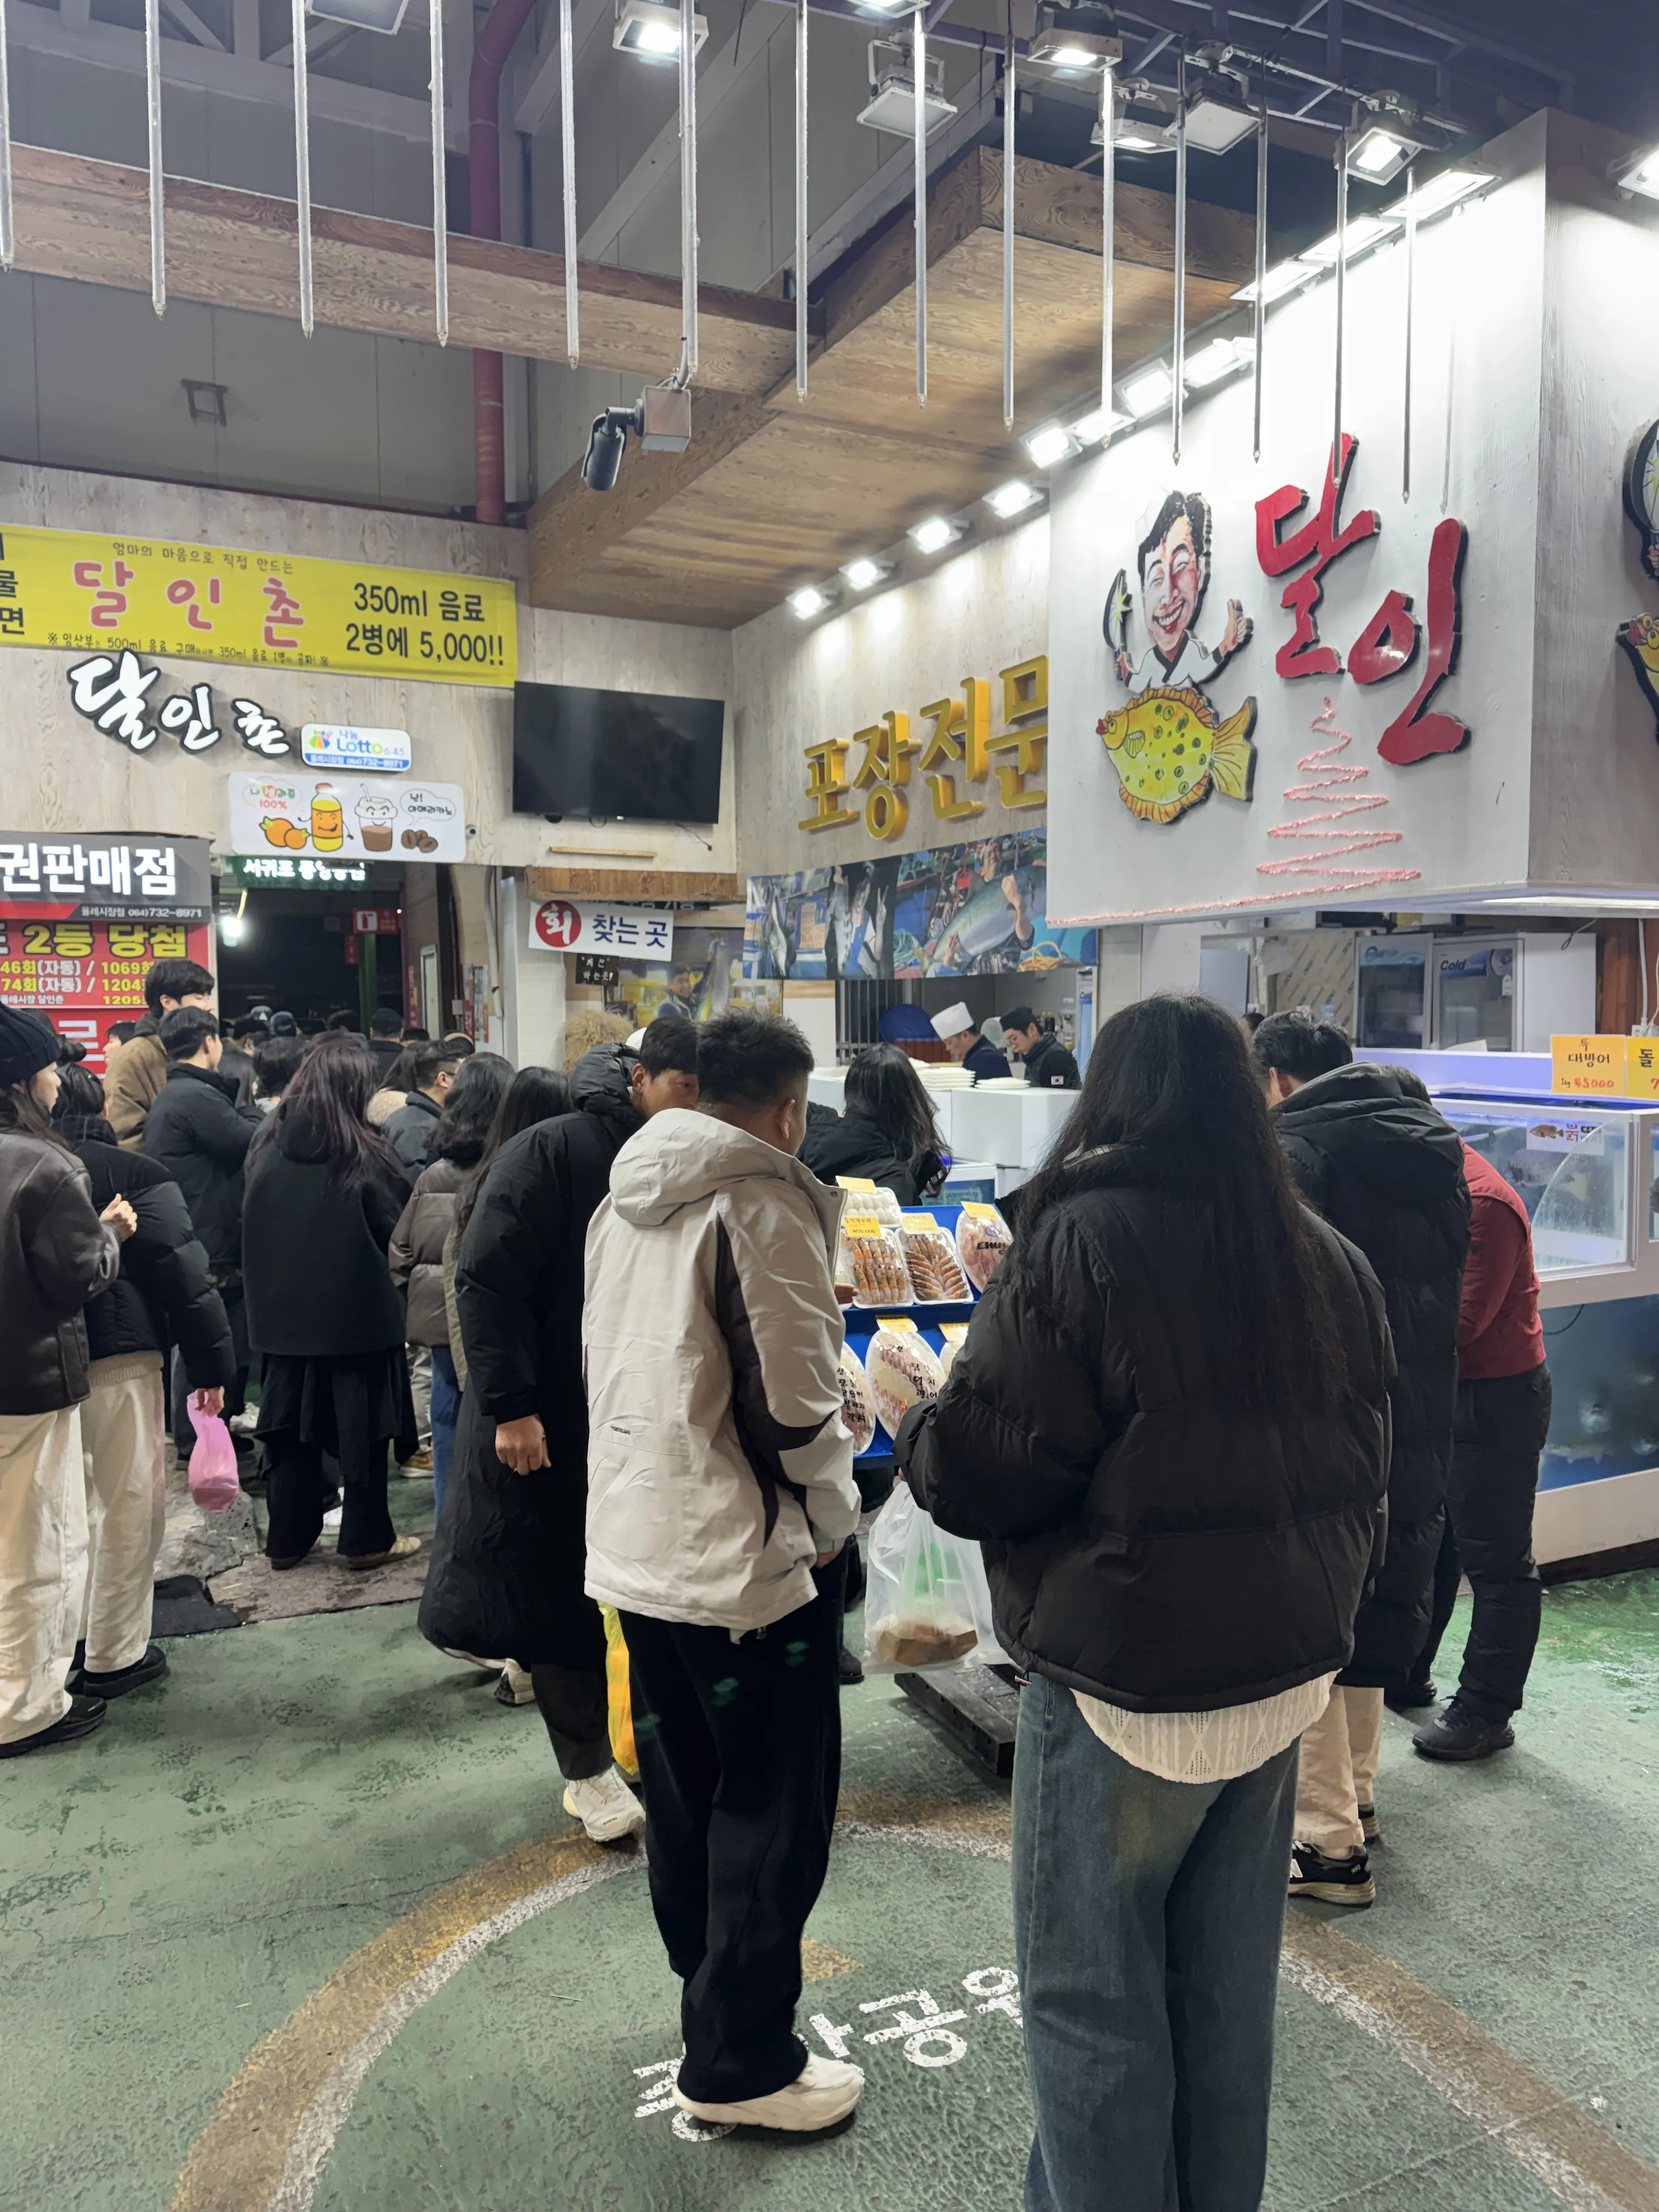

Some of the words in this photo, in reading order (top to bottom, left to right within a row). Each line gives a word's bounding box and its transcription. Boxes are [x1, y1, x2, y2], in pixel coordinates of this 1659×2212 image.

[112, 541, 152, 556] 엄마의
[162, 548, 214, 564] 마음으로
[223, 553, 247, 569] 직접
[256, 557, 294, 574] 만드는
[354, 583, 427, 617] 350ml
[439, 590, 484, 622] 음료
[1255, 431, 1471, 765] 달인
[108, 637, 142, 651] 500ml
[149, 639, 167, 653] 음료
[219, 646, 246, 659] 350ml
[253, 648, 268, 662] 음료
[346, 623, 408, 658] 2병에
[420, 631, 504, 665] 5,000!!
[336, 738, 383, 755] Lotto
[798, 654, 1048, 840] 포장전문
[259, 800, 288, 810] 100%
[0, 843, 176, 895] 권판매점
[243, 858, 296, 878] 서귀포
[22, 923, 94, 958] 2등
[108, 923, 188, 958] 당첨
[541, 902, 572, 945] 회
[592, 913, 640, 945] 찾는
[645, 921, 668, 949] 곳
[1440, 959, 1466, 971] Cold
[1568, 1053, 1610, 1068] 대방어
[1638, 1048, 1655, 1068] 돌
